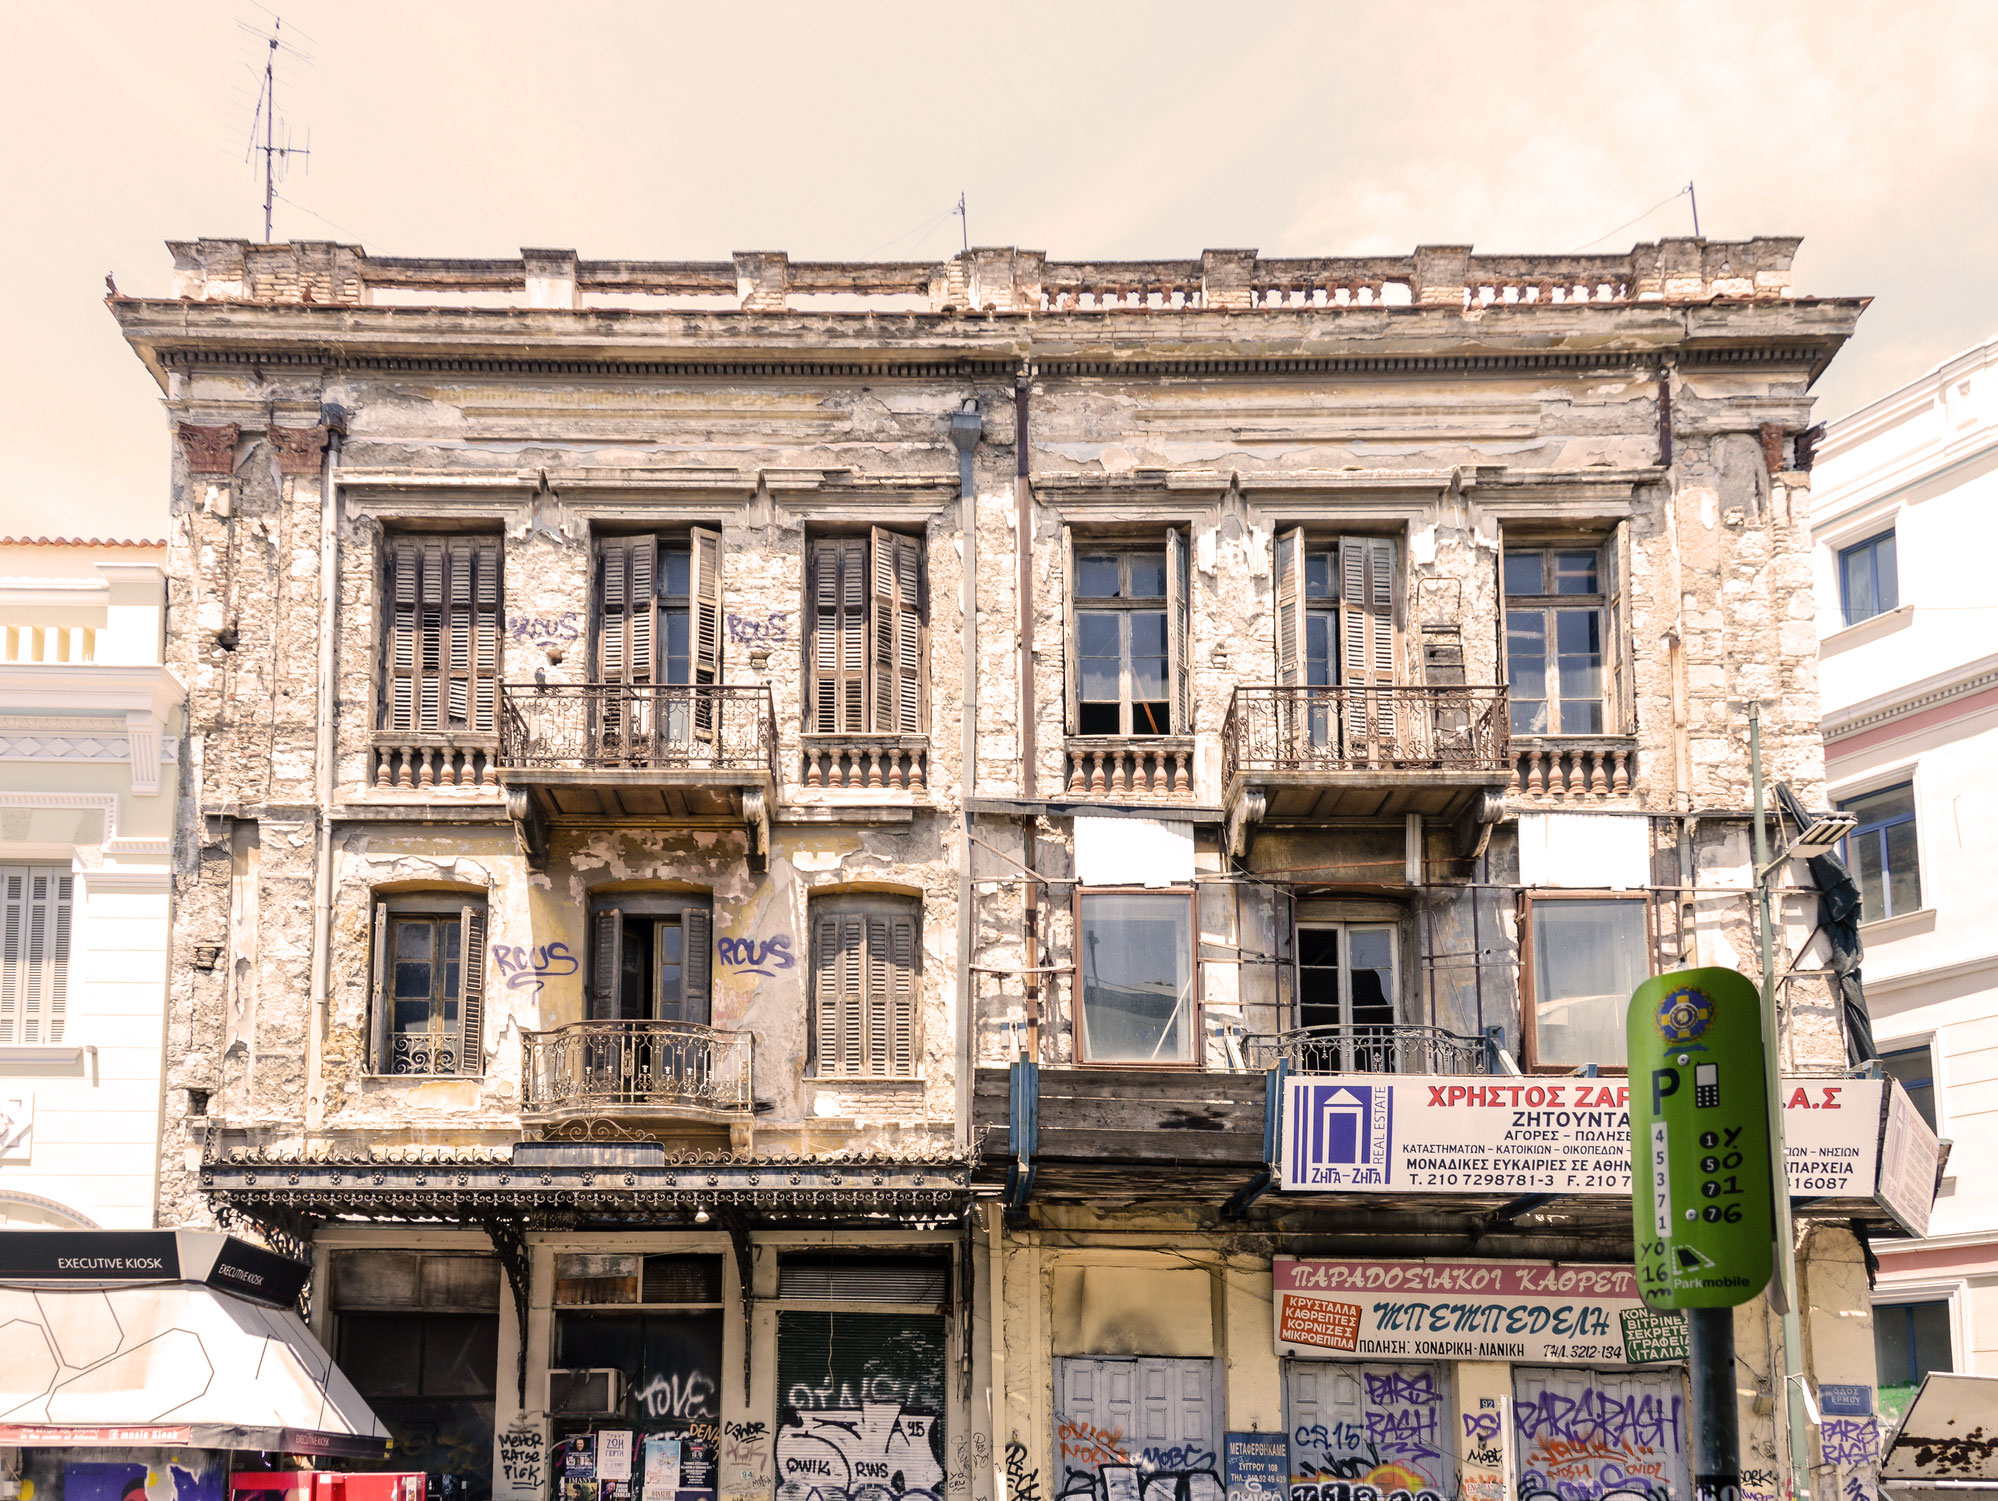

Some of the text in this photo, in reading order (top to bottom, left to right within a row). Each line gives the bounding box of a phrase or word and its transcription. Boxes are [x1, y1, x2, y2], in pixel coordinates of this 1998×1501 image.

[1427, 1085, 1565, 1108] ΧΡΗΣΤΟΣ
[1574, 1086, 1631, 1109] ΖΑΡ
[1652, 1067, 1680, 1115] P
[1373, 1086, 1386, 1165] REAL ESTATE
[1512, 1111, 1630, 1128] ΖΗΤΟΥΝΤΑ
[1504, 1130, 1559, 1141] ΑΓΟΡΕΣ
[1575, 1130, 1631, 1142] ΠΩΛΗΣΕ
[1403, 1144, 1485, 1154] ΚΑΤΑΣΤΗΜΑΤΩΝ
[1496, 1145, 1551, 1155] ΚΑΤΟΙΚΙΩΝ
[1563, 1145, 1623, 1155] ΟΙΚΟΠΕΔΩΝ
[1785, 1147, 1807, 1157] ΙΩΝ
[1819, 1147, 1859, 1157] ΝΗΣΙΩΝ
[1407, 1158, 1853, 1174] ΜΟΝΑΔΙΚΕΣ ΕΥΚΑΙΡΙΕΣ ΣΕ ΑΘΗΝ ΠΑΡΧΕΙΑ
[1428, 1174, 1458, 1185] 210
[1463, 1174, 1554, 1187] 7298781-3
[1567, 1175, 1580, 1187] F.
[1586, 1175, 1616, 1187] 210
[1621, 1176, 1632, 1187] 7
[1787, 1177, 1847, 1190] 16087
[58, 1257, 163, 1269] EXECUTIVE KIOSK
[218, 1263, 265, 1287] EXECUTIVE KIOSK
[1515, 1268, 1636, 1293] ΚΑΘΡΕΠ
[1673, 1276, 1750, 1290] Parkmobile
[1289, 1296, 1357, 1317] ΚΡΥΣΤΑΛΛΑ
[1622, 1309, 1657, 1320] ΚΟΝ
[1285, 1307, 1357, 1327] ΚΑΘΡΕΠΤΕΣ
[1287, 1318, 1353, 1338] ΚΟΡΝΙΖΕΣ
[1625, 1325, 1689, 1341] ΣΕΚΡΕΤΕ
[1282, 1328, 1355, 1350] ΜΙΚΡΟΕΠΙΠΛΑ
[1482, 1399, 1494, 1408] 92
[1832, 1396, 1860, 1404] ΕΡΜΟΥ
[1229, 1442, 1287, 1457] ΜΕΤΑΦΕΡΘΗΚΑΜΕ
[1238, 1462, 1265, 1471] ΣΥΓΓΡΟΥ
[742, 1471, 753, 1479] 94
